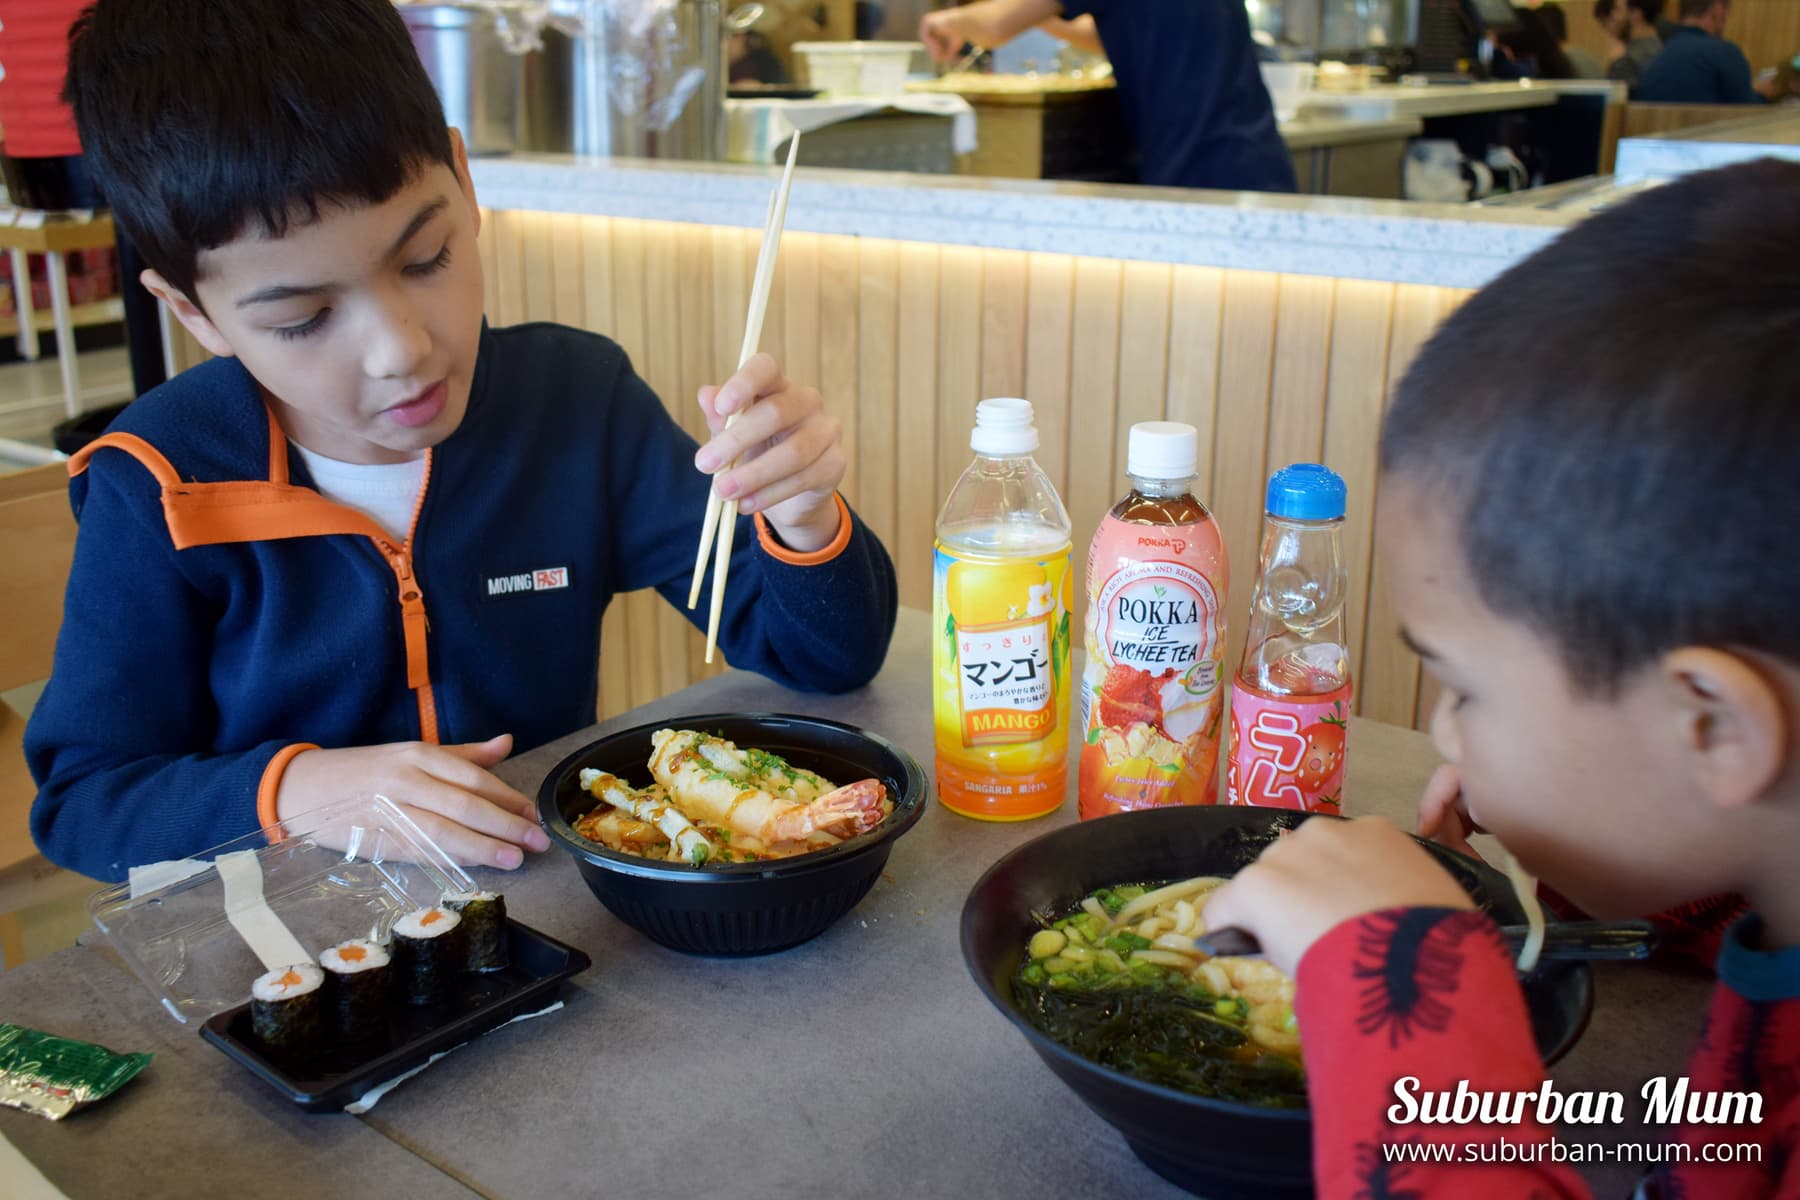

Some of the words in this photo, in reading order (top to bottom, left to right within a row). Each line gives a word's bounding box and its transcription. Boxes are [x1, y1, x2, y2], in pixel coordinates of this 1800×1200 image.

[1138, 537, 1171, 548] POKKA
[1154, 565, 1173, 574] AND
[487, 573, 533, 595] MOVING
[535, 568, 565, 589] FAST
[1118, 596, 1199, 625] POKKA
[1142, 625, 1169, 641] ICE
[1112, 640, 1169, 663] LYCHEE
[1171, 643, 1199, 663] TEA
[962, 648, 1048, 687] マンゴー
[972, 709, 1051, 732] MANGO
